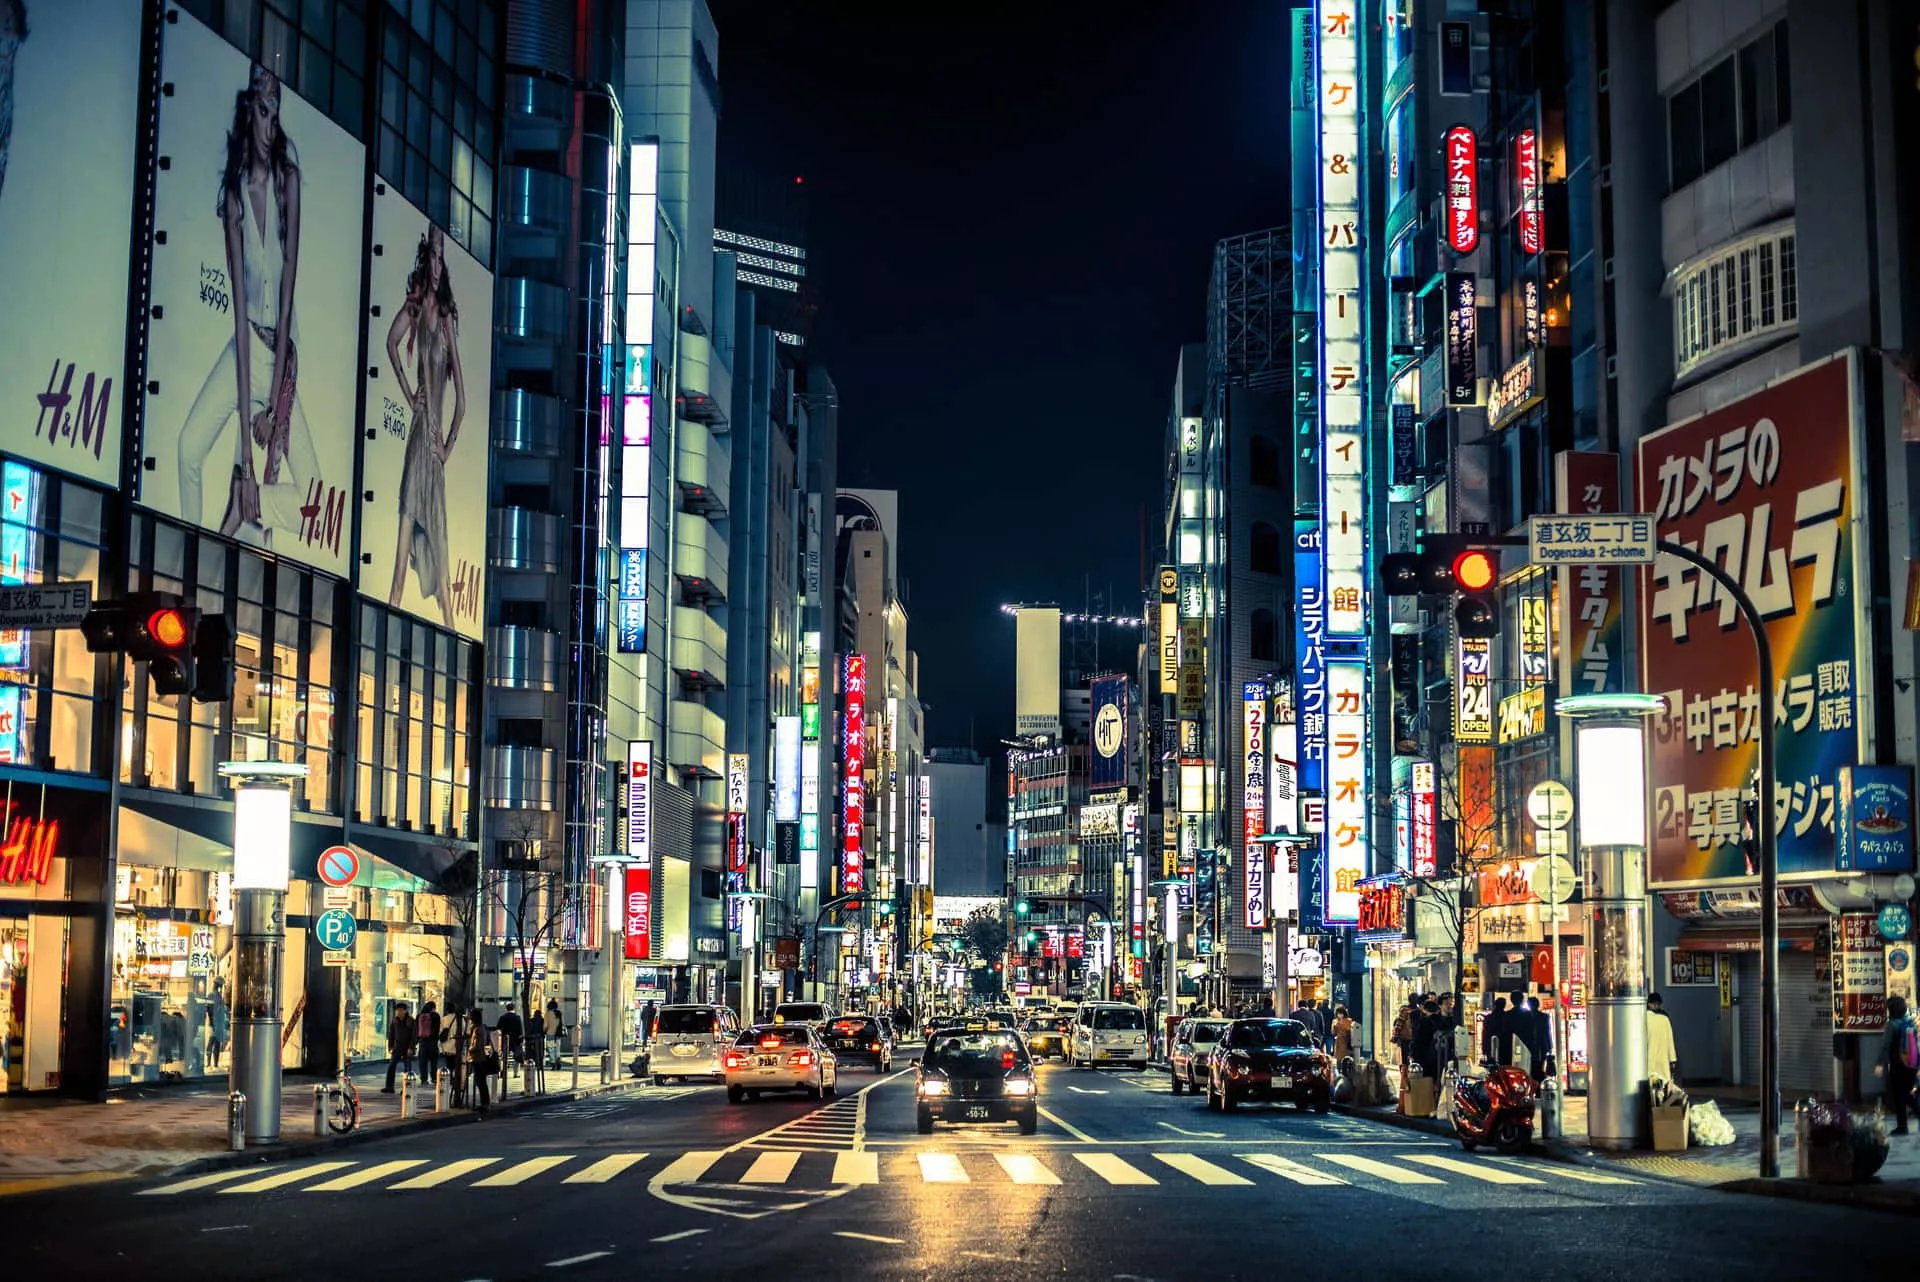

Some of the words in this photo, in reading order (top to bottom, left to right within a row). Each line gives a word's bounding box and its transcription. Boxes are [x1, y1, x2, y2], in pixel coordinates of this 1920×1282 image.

[200, 280, 229, 315] ¥999
[36, 357, 112, 461] H&M
[1455, 386, 1471, 398] 5F
[1657, 418, 1780, 525] カメラの
[300, 477, 346, 558] H&M
[1536, 521, 1649, 544] 道玄坂二丁目
[1540, 546, 1595, 560] Dogenzaka
[1599, 546, 1646, 559] 2-chome
[1652, 478, 1843, 640] キタムラ
[452, 559, 481, 624] H&M
[1580, 564, 1608, 694] キタムラ
[1817, 660, 1850, 694] 買取
[1462, 686, 1489, 721] 24
[1463, 720, 1489, 733] OPEN
[1656, 694, 1682, 744] 3F
[1687, 672, 1814, 752] 中古カメラ
[1818, 695, 1852, 732] 販売
[1250, 709, 1261, 750] 270
[631, 782, 646, 844] MARUHAN
[1335, 689, 1362, 894] カラオケ館
[1657, 789, 1683, 839] 2F
[1688, 774, 1835, 850] 写真タジオ
[628, 892, 648, 913] CLUB
[1247, 853, 1264, 925] チカラめし
[326, 918, 342, 945] P
[628, 914, 648, 936] SEGA
